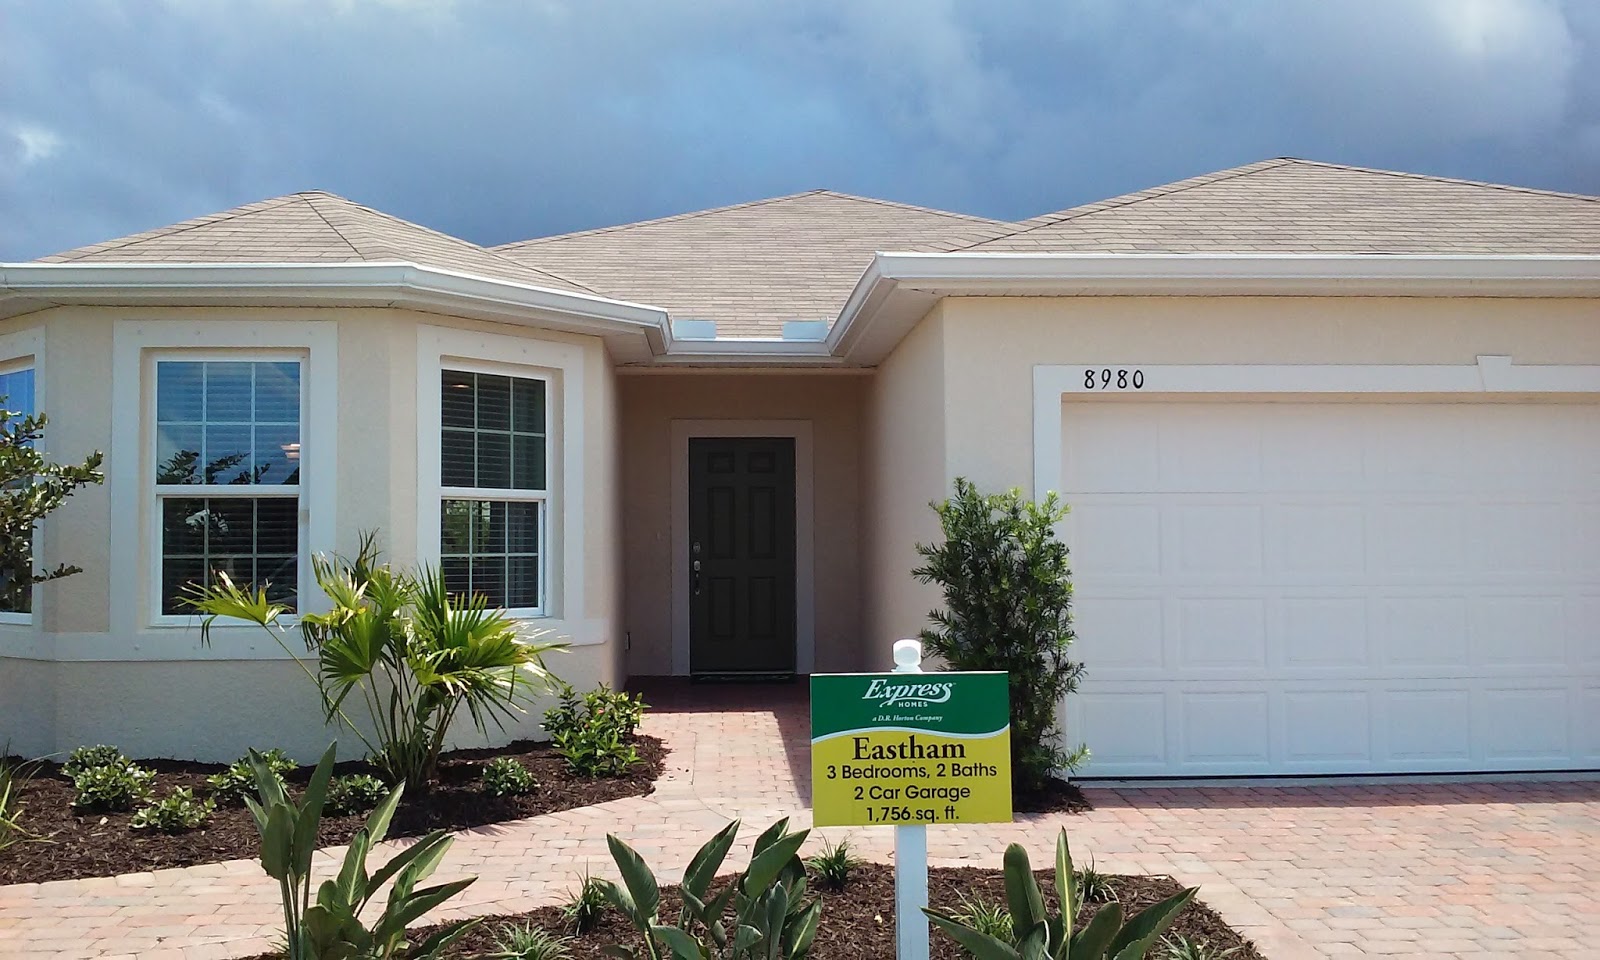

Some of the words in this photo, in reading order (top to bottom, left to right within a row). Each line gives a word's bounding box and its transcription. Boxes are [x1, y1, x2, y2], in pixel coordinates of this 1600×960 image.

[1084, 368, 1144, 390] 8980
[861, 679, 953, 708] Express
[893, 714, 914, 722] Horton
[915, 714, 943, 723] Company
[852, 735, 966, 760] Eastham
[827, 765, 837, 779] 3
[842, 764, 930, 779] Bedrooms,
[936, 763, 947, 777] 2
[951, 762, 997, 777] Baths
[854, 786, 864, 800] 2
[869, 785, 900, 800] Car
[905, 784, 971, 801] Garage
[915, 810, 939, 823] sq.
[944, 805, 960, 820] ft.
